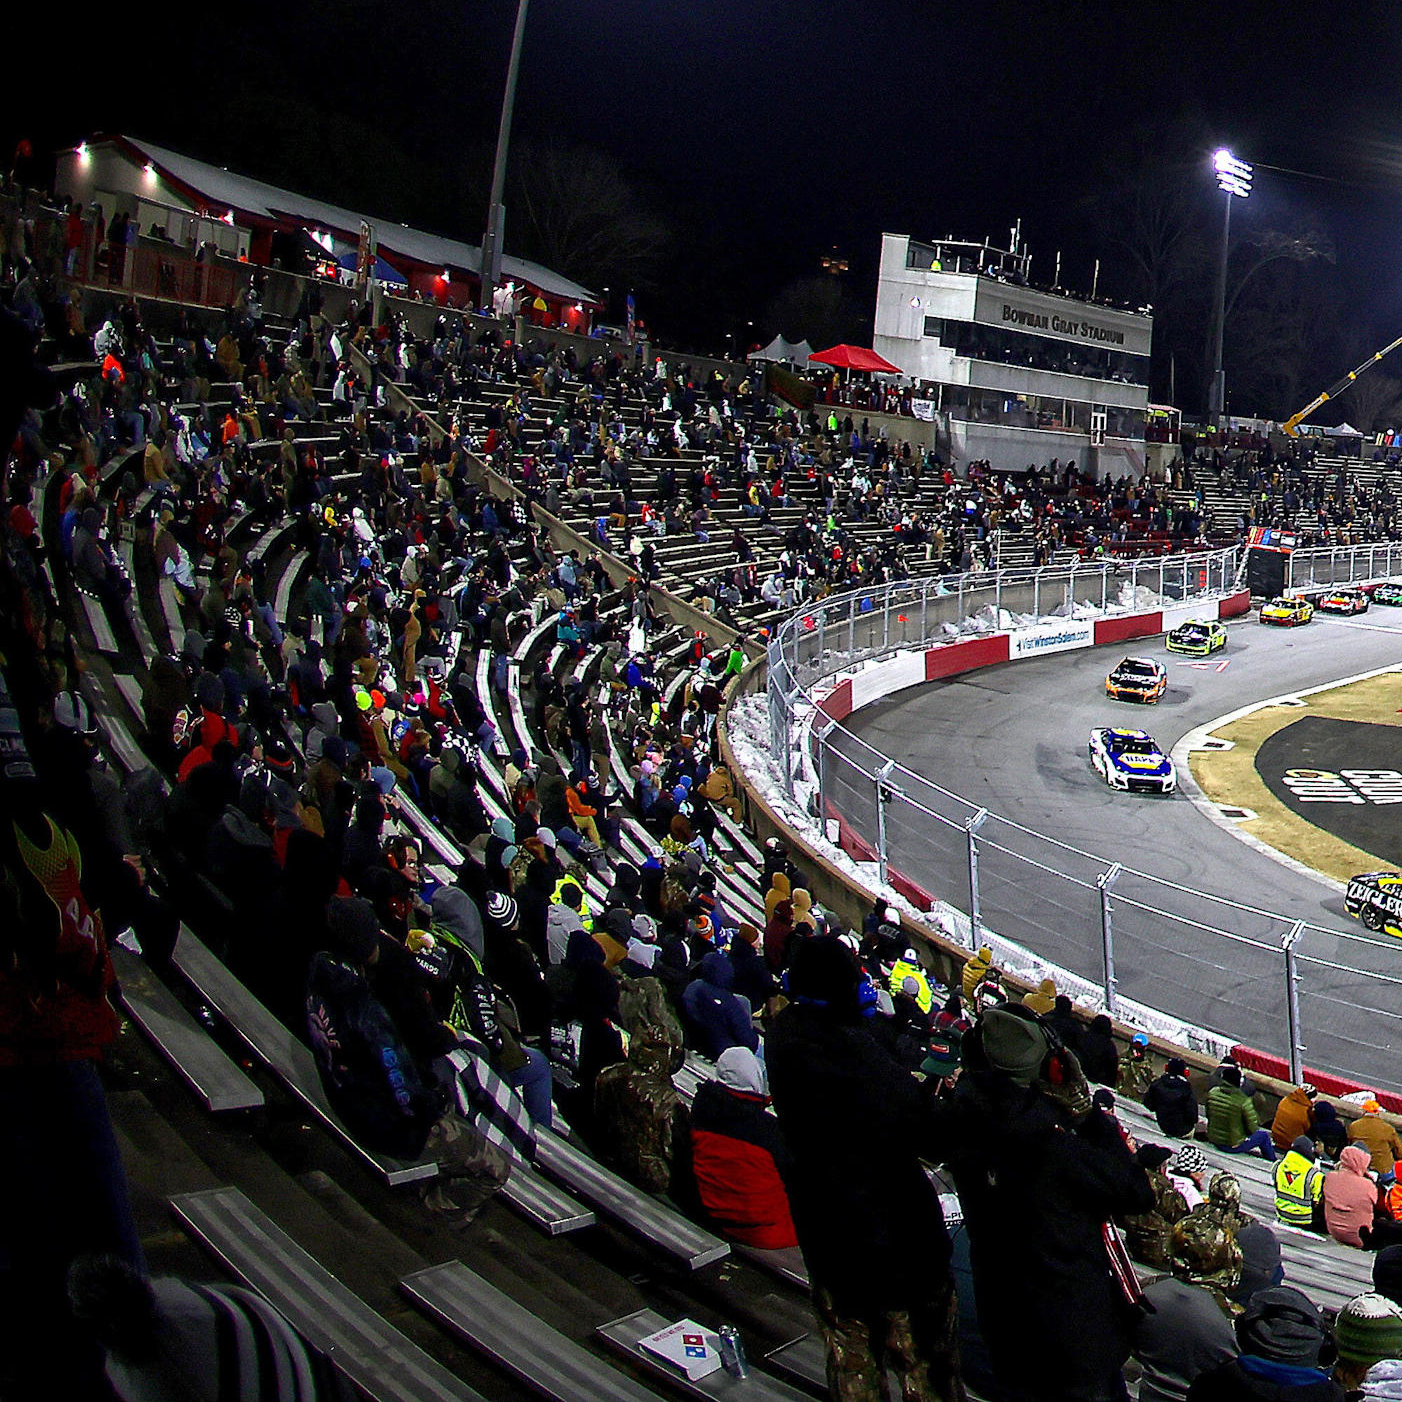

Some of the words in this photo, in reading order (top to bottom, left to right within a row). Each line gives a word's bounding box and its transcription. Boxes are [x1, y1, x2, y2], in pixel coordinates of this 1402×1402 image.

[1002, 304, 1049, 330] BOWMAN
[1052, 315, 1079, 336] GRAY
[1081, 322, 1125, 345] STADIUM
[1281, 776, 1367, 805] OUT
